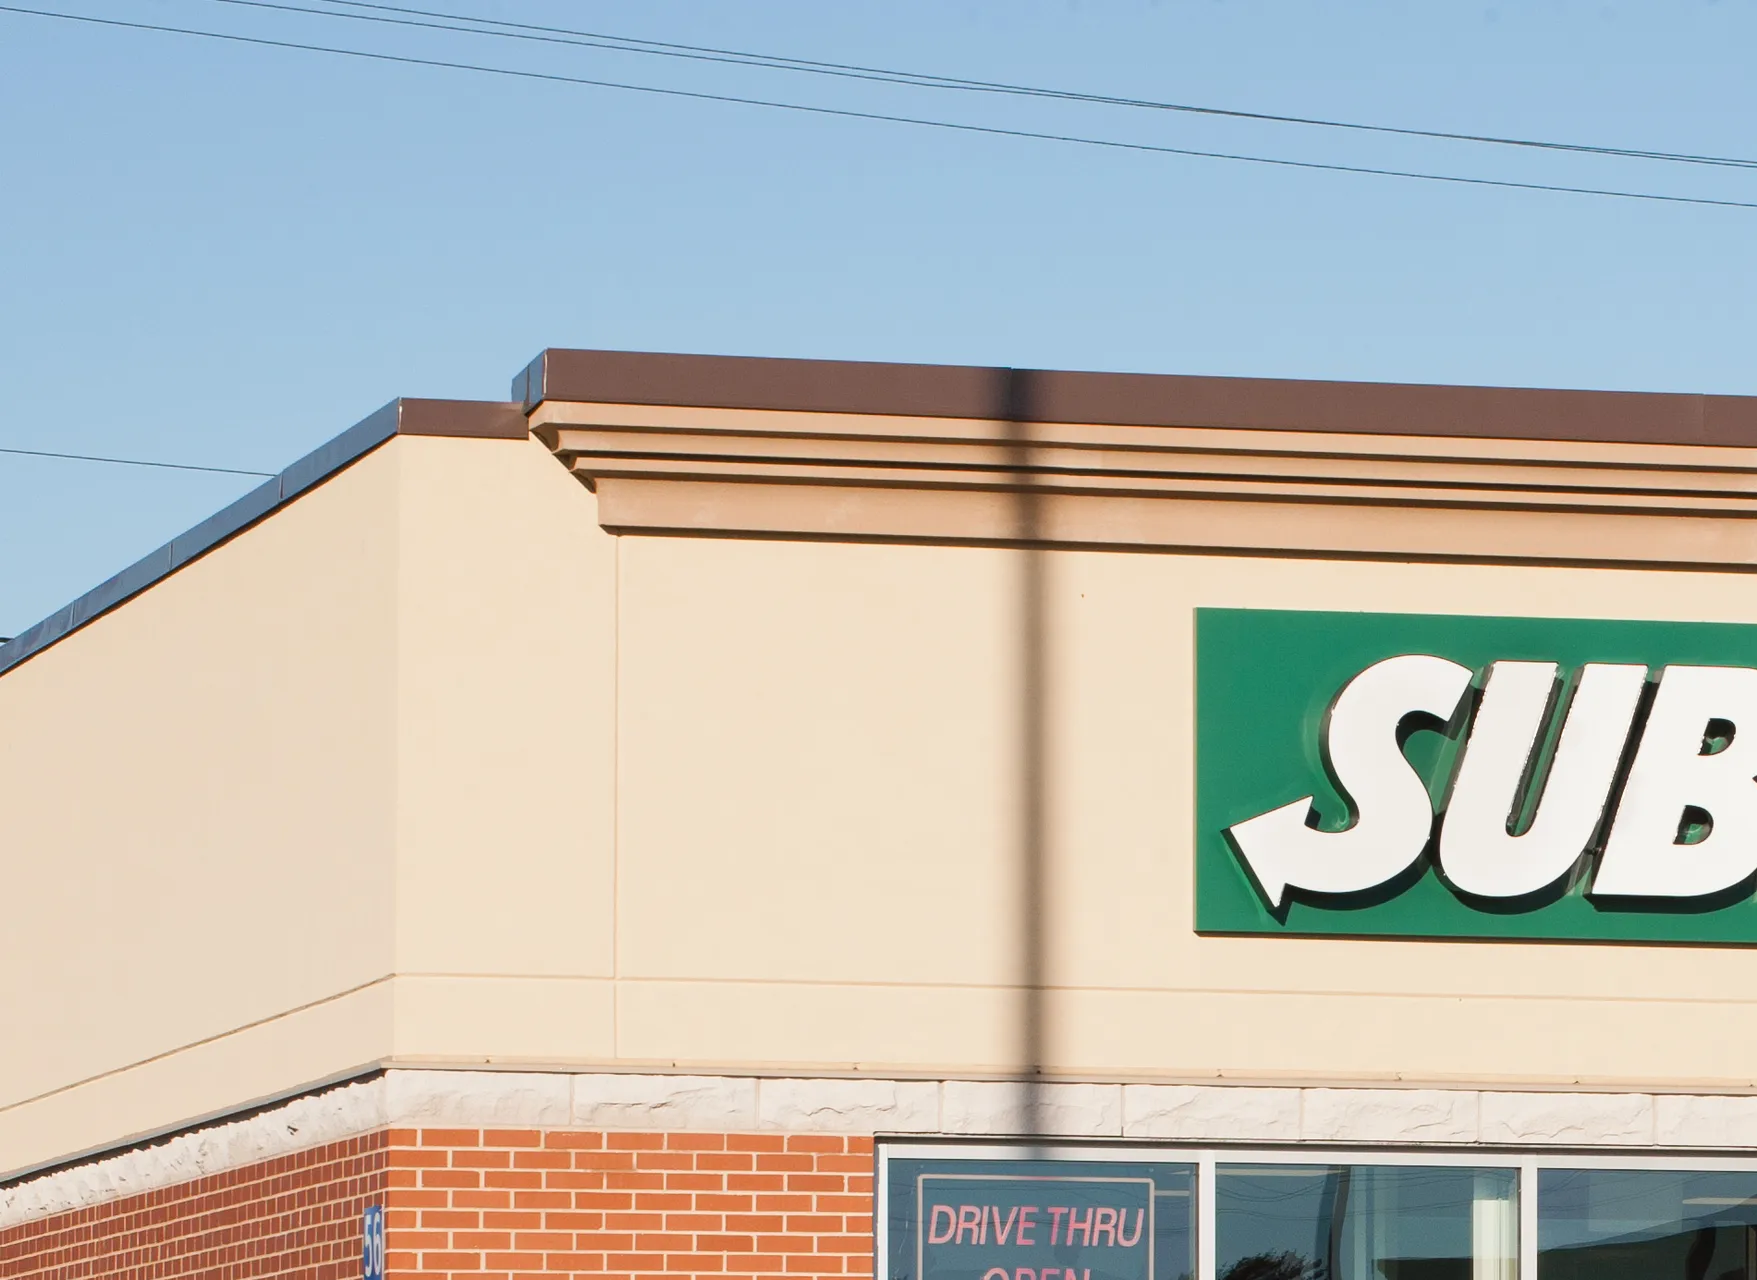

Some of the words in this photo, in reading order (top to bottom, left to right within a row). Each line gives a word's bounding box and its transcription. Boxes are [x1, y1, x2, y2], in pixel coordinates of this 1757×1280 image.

[364, 1212, 381, 1278] 56
[928, 1204, 1039, 1246] DRIVE
[1047, 1206, 1145, 1248] THRU
